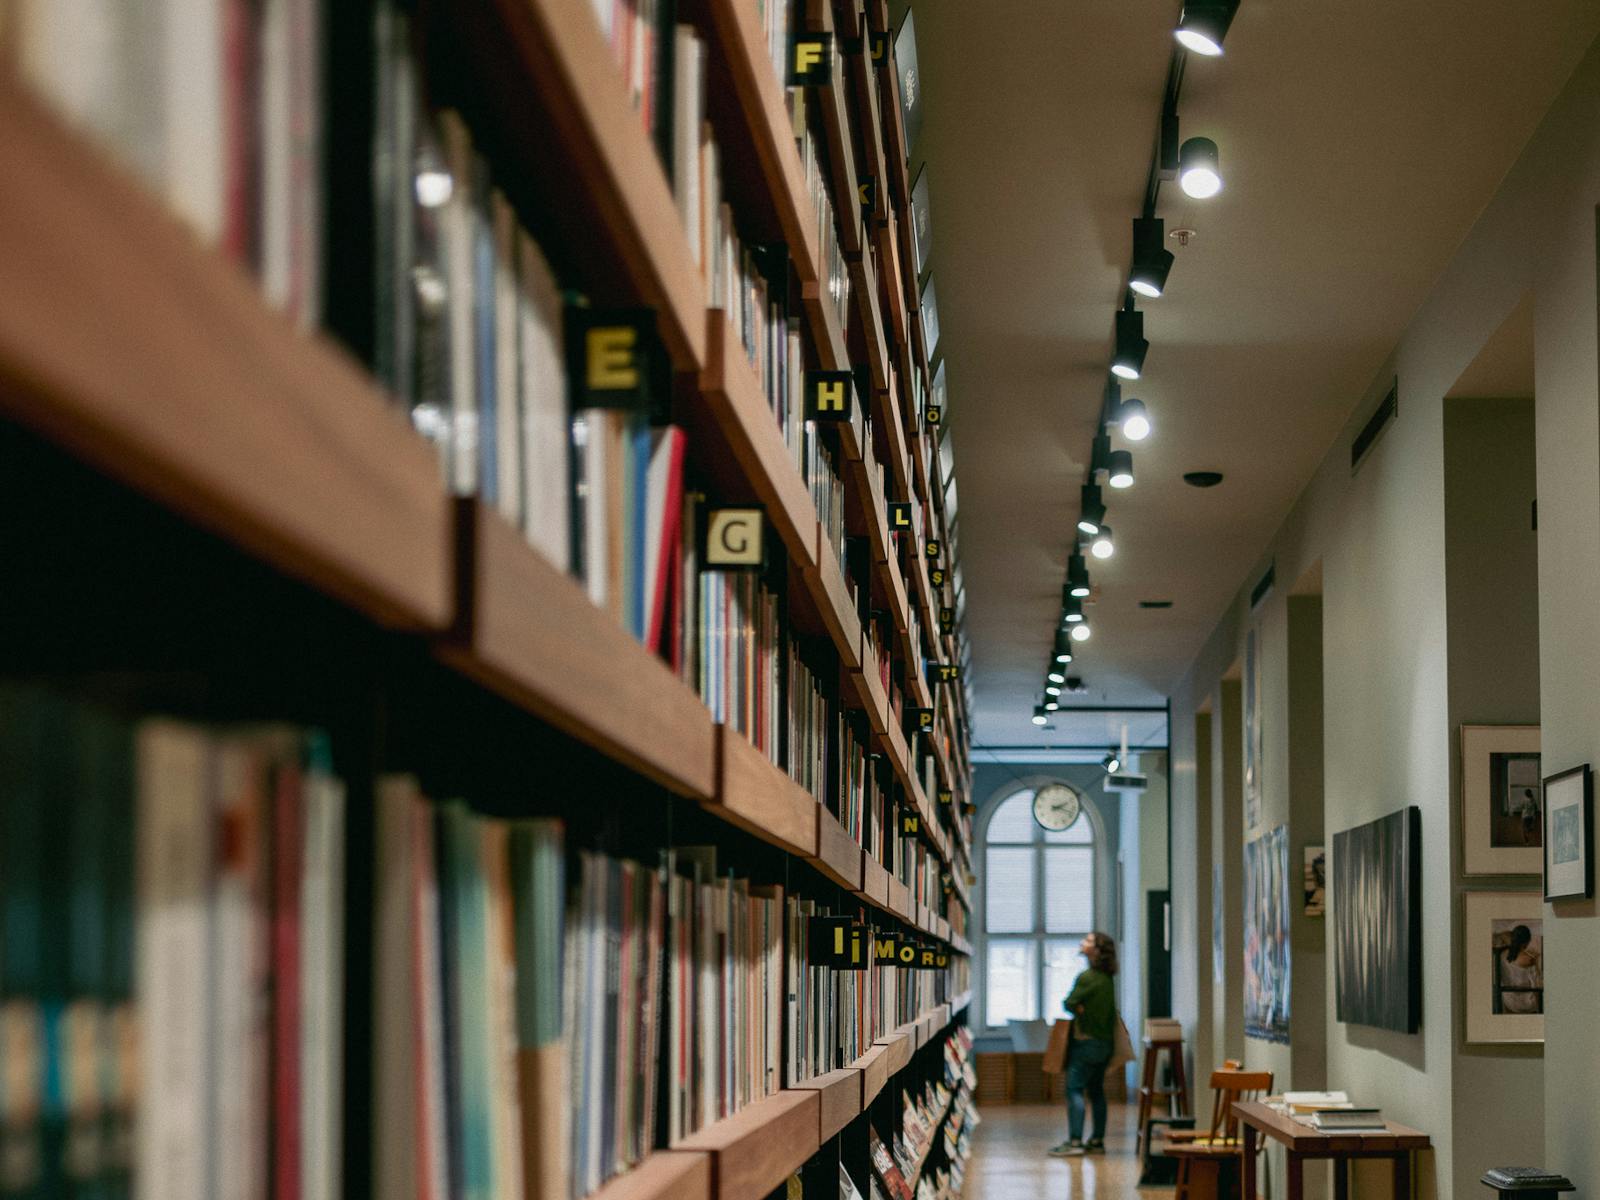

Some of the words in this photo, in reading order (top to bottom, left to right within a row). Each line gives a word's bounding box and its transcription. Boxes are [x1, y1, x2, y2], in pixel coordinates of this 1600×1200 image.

[796, 42, 823, 73] F
[586, 326, 637, 390] E
[817, 382, 843, 411] H
[896, 509, 909, 526] L
[721, 521, 748, 554] G
[927, 543, 938, 555] S
[940, 668, 950, 680] T
[920, 713, 932, 727] P
[939, 793, 952, 803] W
[904, 818, 918, 833] N
[875, 940, 895, 959] M
[899, 946, 915, 962] O
[922, 952, 934, 965] R
[936, 956, 947, 967] U
